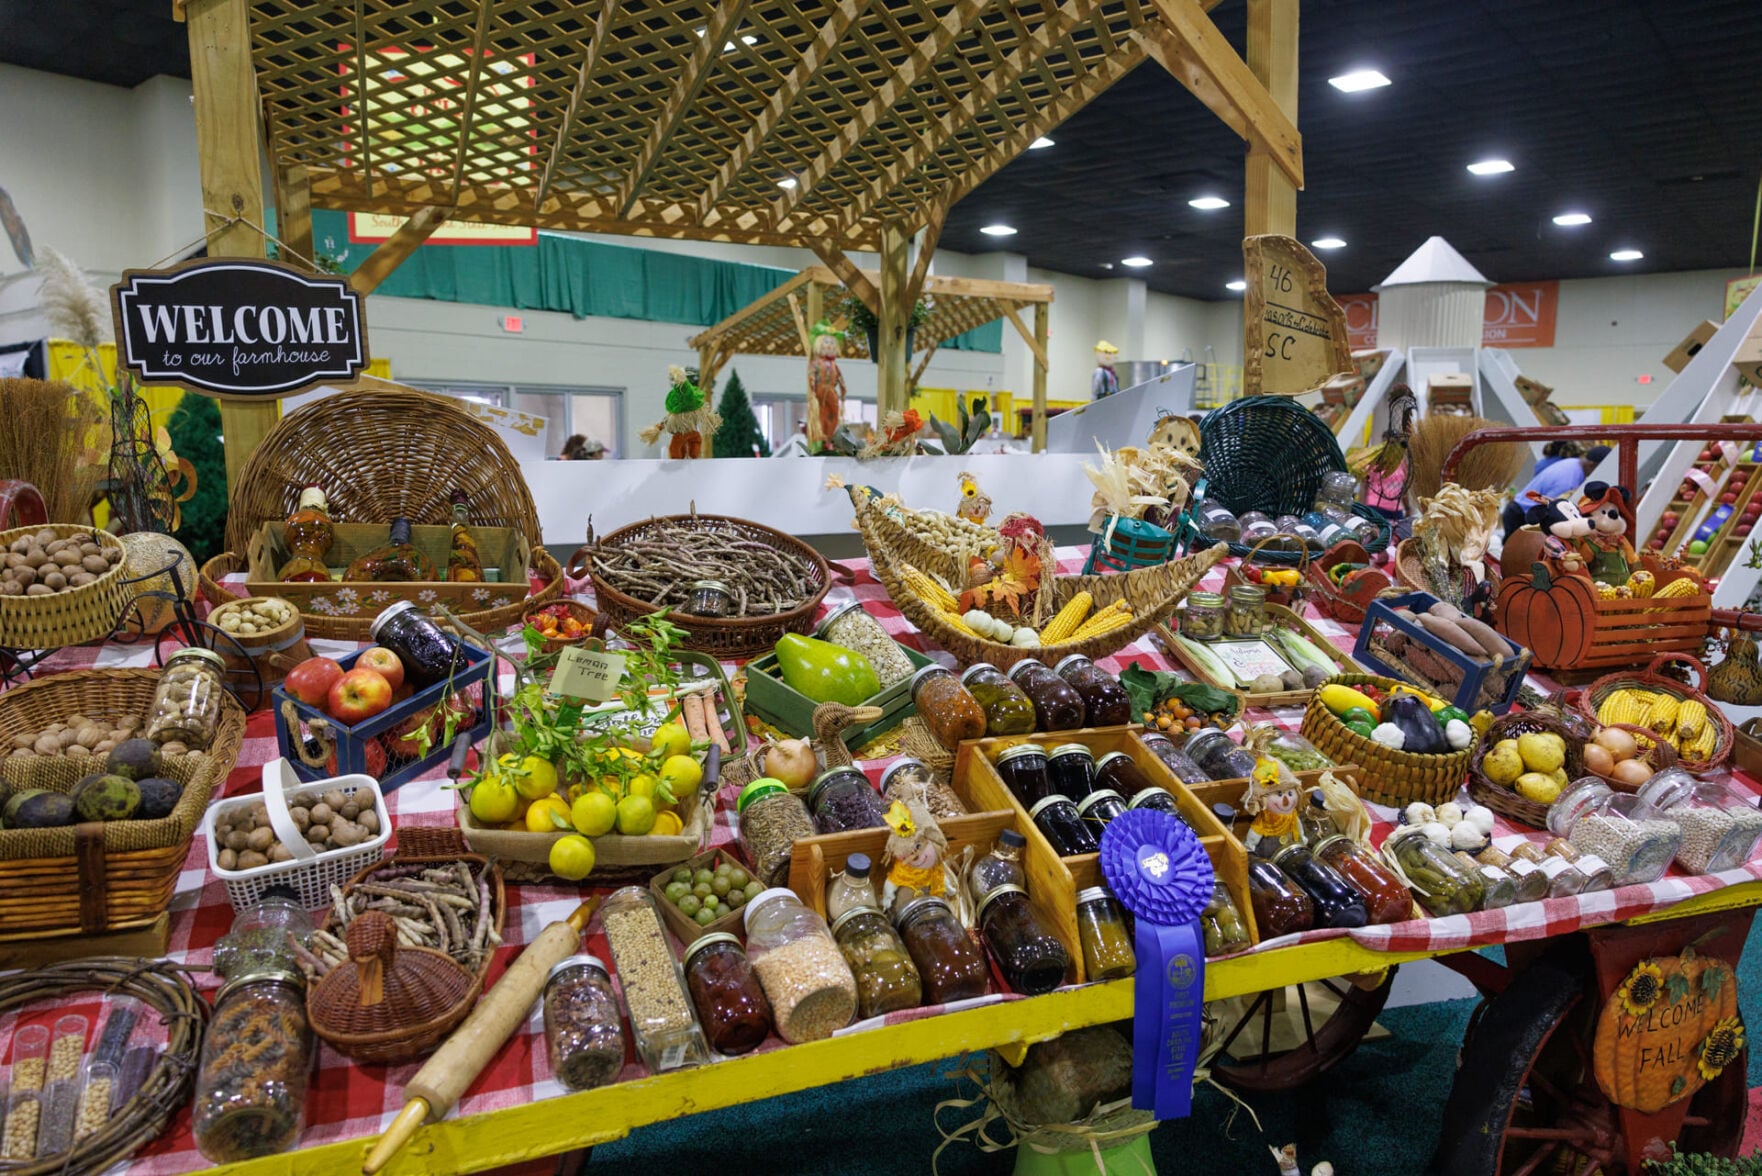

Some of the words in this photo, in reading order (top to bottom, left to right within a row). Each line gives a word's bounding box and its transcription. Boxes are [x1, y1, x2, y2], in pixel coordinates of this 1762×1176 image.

[1270, 264, 1293, 293] 46
[137, 304, 349, 344] WELCOME
[162, 350, 182, 367] to
[190, 351, 226, 367] our
[232, 344, 332, 377] farmhouse
[1264, 332, 1296, 361] SC
[1617, 994, 1704, 1040] WELCOME
[1640, 1038, 1686, 1074] FALL
